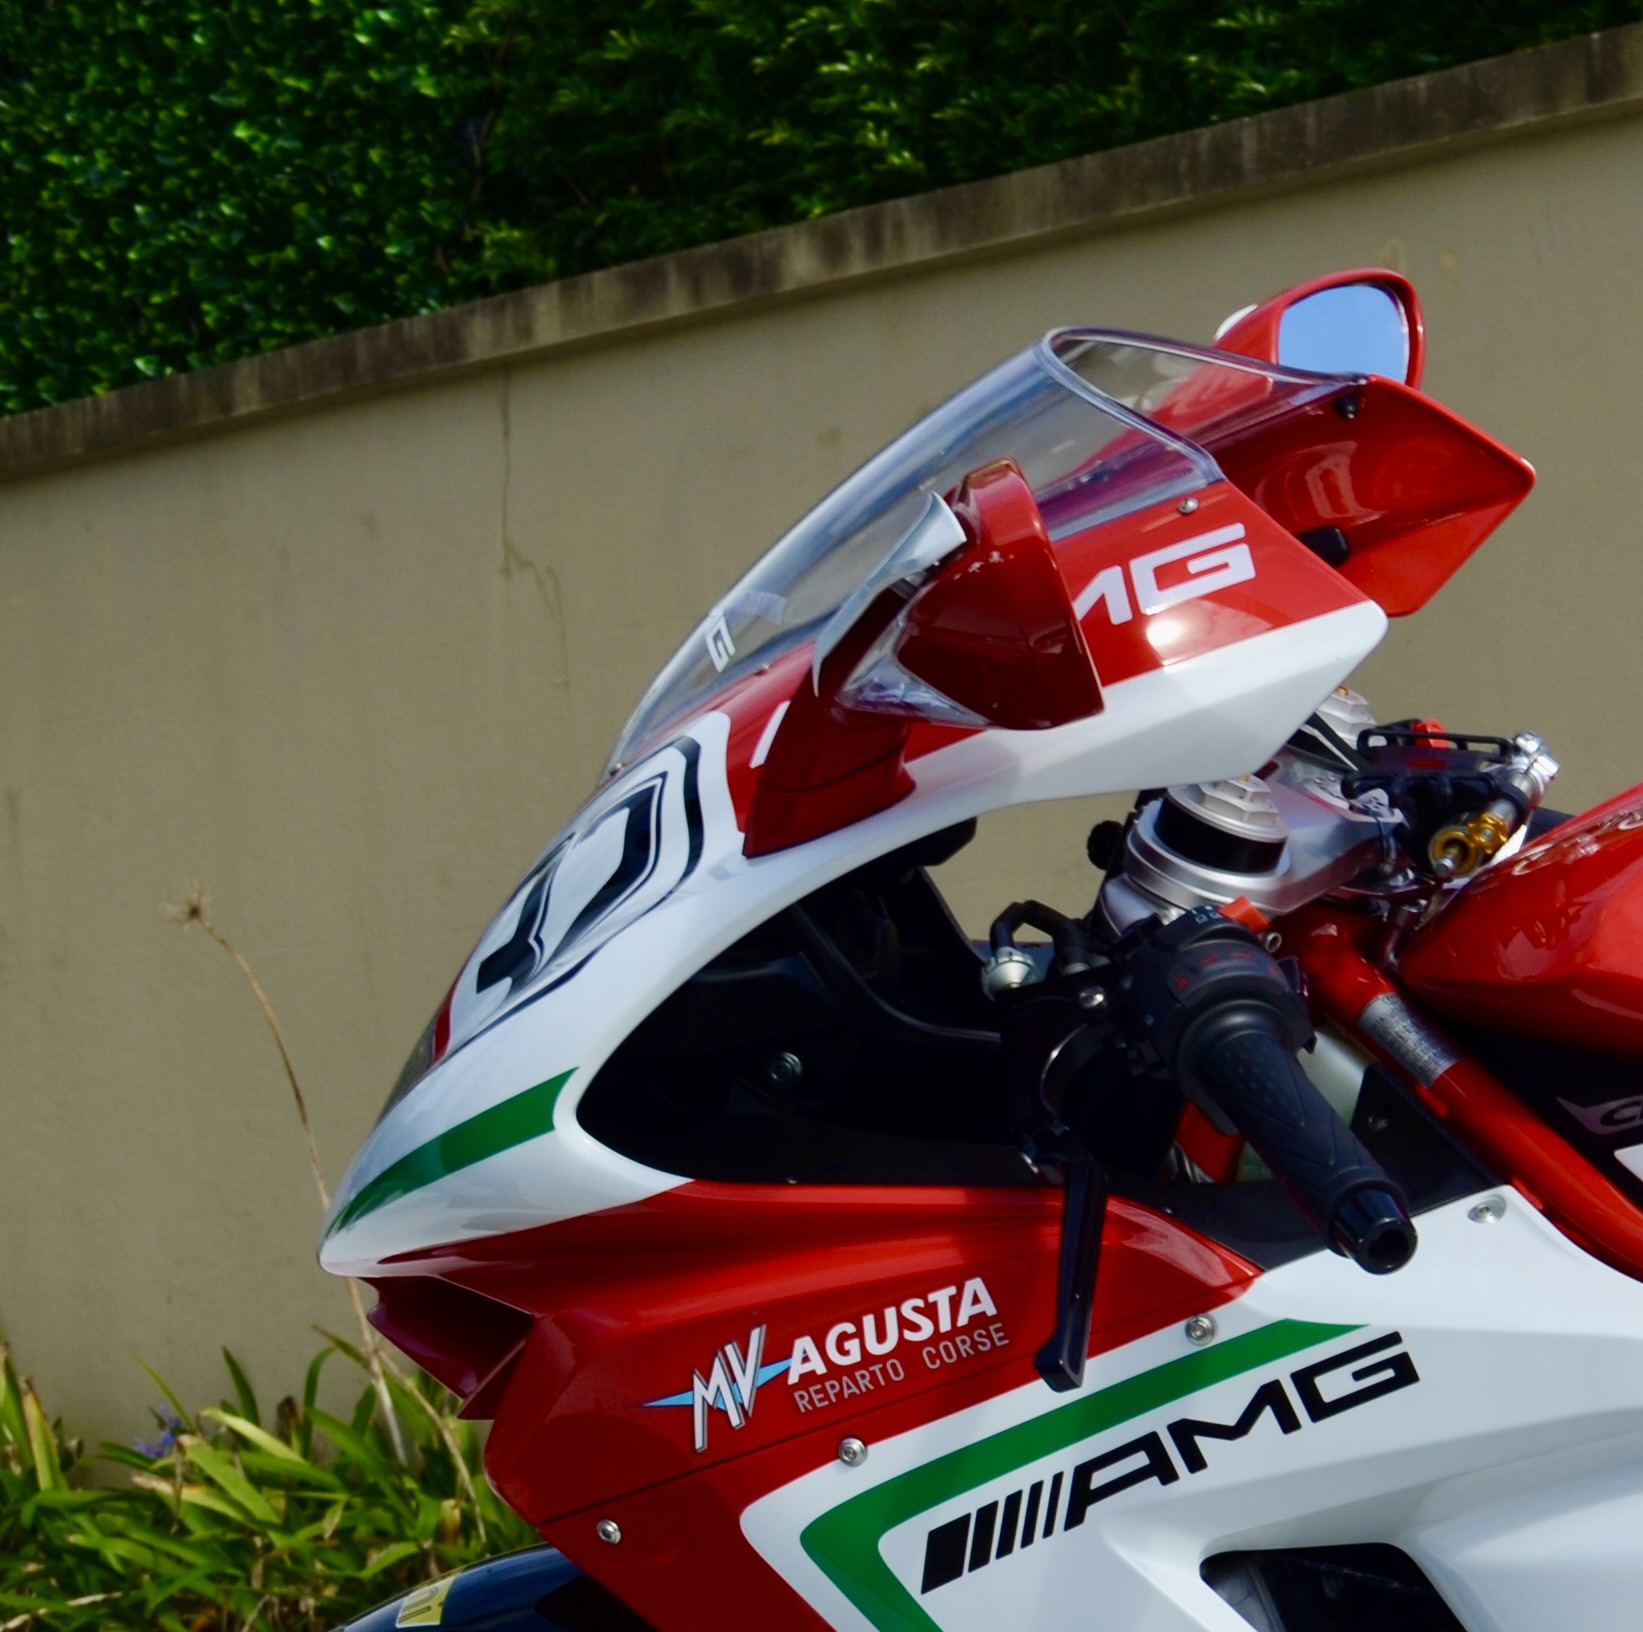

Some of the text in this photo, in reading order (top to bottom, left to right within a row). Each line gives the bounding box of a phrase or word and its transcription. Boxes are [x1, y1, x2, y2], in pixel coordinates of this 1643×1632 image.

[692, 1276, 999, 1454] MV AGUSTA
[793, 1322, 1010, 1413] REPARTO CORSE
